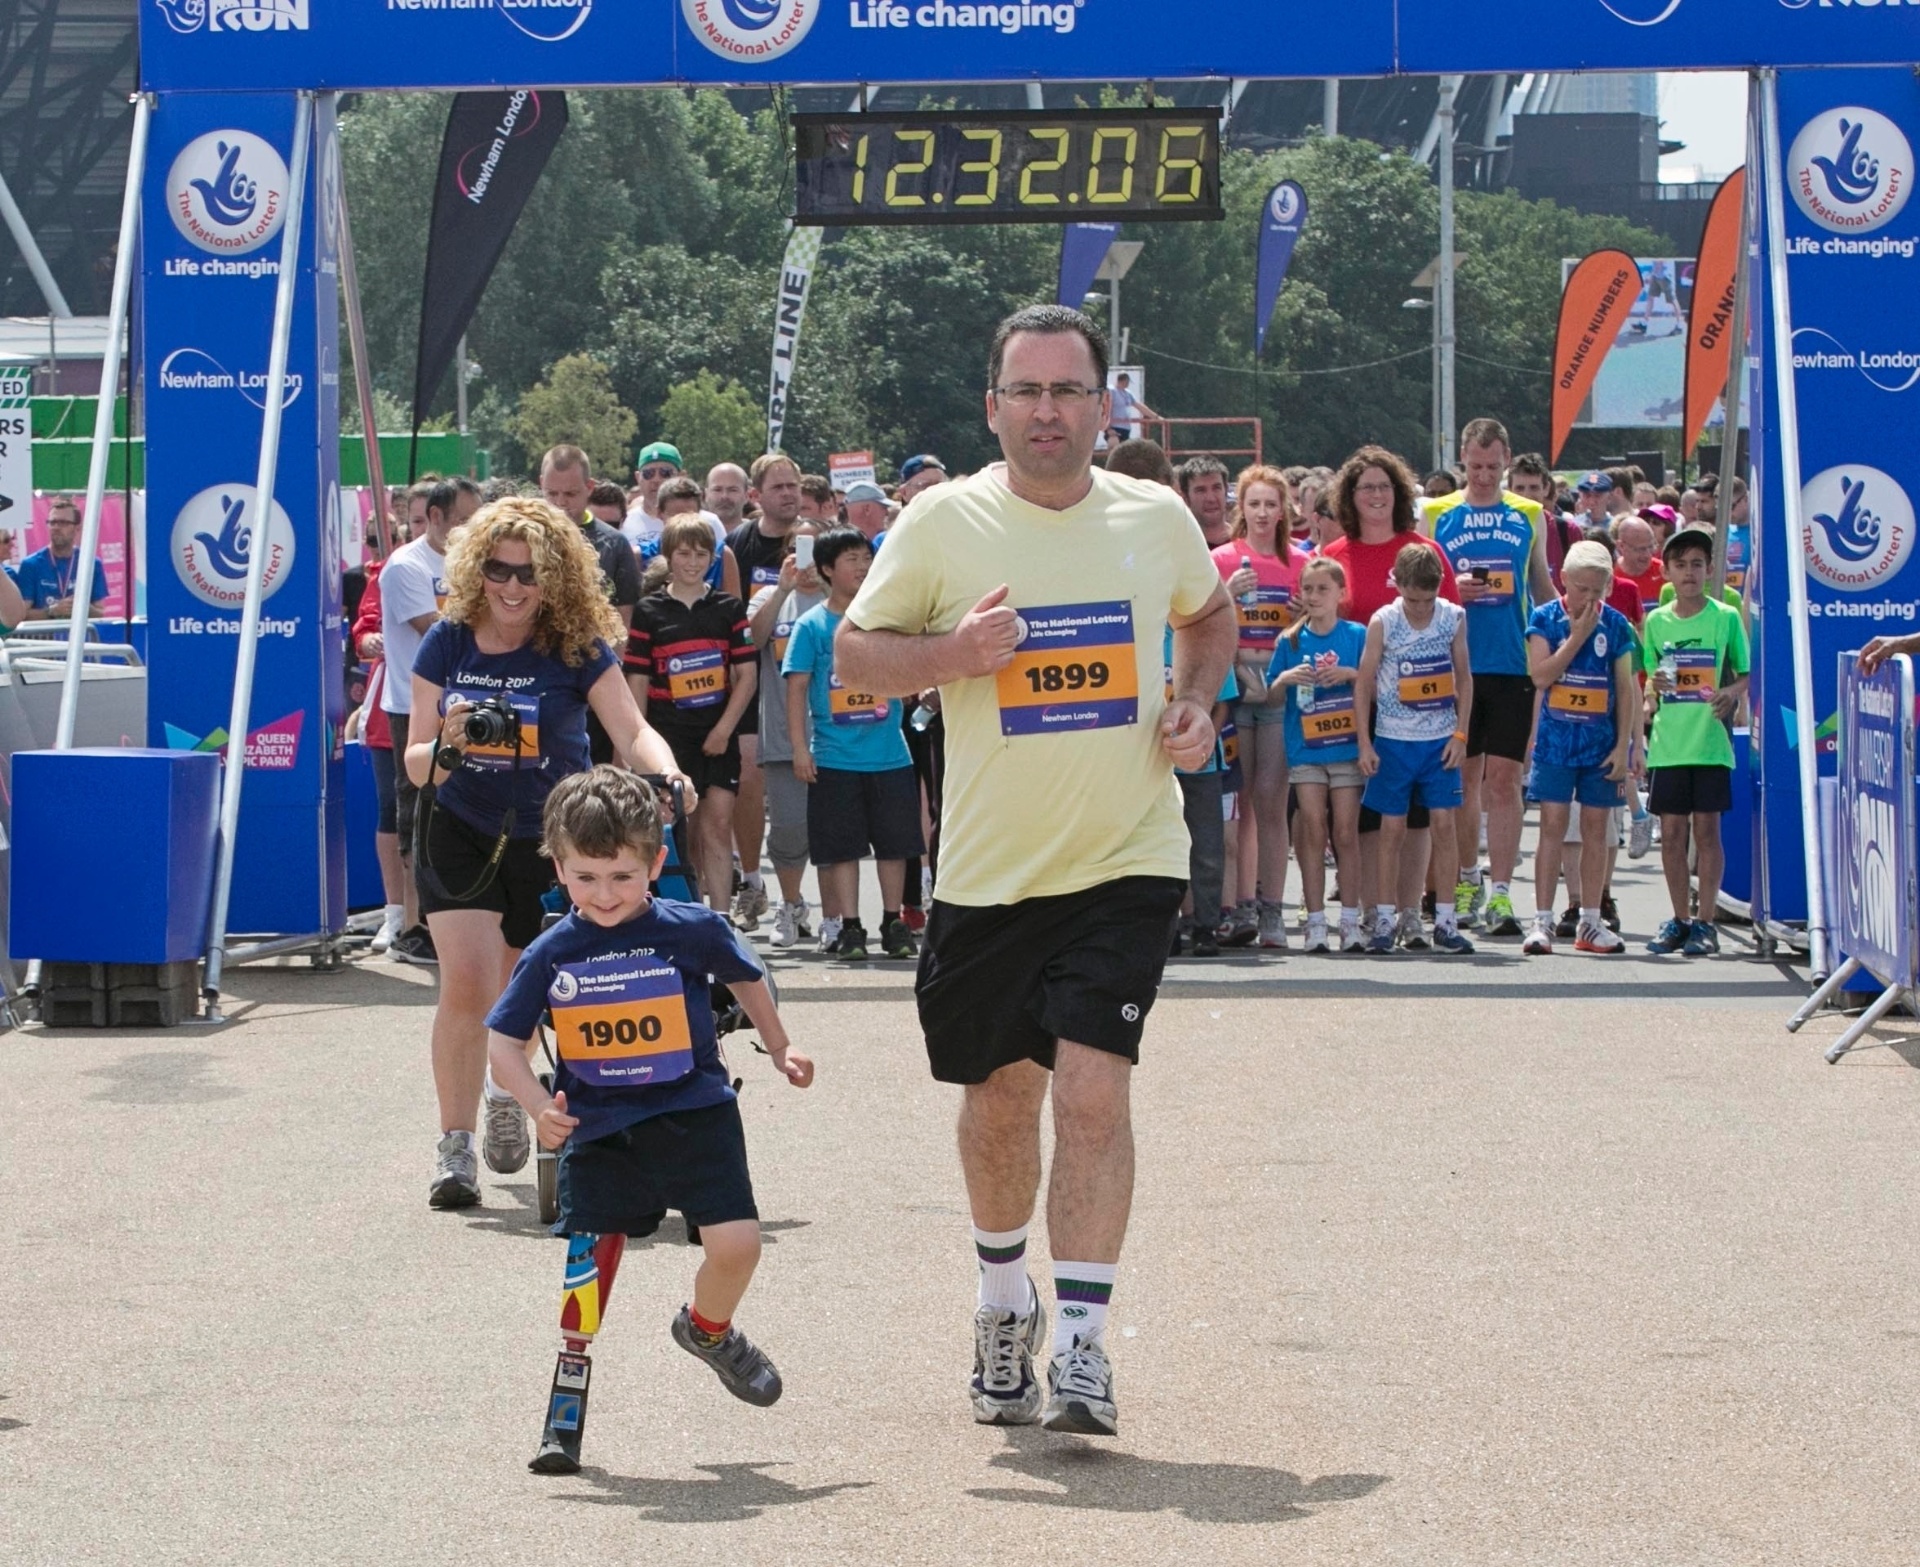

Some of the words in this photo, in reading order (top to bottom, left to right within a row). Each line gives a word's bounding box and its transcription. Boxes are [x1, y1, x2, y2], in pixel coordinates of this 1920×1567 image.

[850, 0, 909, 28] Life
[916, 0, 1075, 34] changing
[704, 23, 772, 55] National
[772, 0, 804, 46] Lotter
[467, 138, 506, 204] Newham
[495, 89, 530, 137] Londo
[1799, 168, 1813, 197] The
[1809, 197, 1870, 227] National
[1870, 168, 1903, 219] Lottery
[178, 190, 192, 219] The
[188, 219, 249, 248] National
[249, 190, 280, 240] Lottery
[1786, 237, 1820, 254] Life
[1823, 236, 1914, 258] changing
[165, 259, 199, 276] Life
[202, 258, 282, 279] changin
[776, 271, 807, 361] LINE
[1700, 273, 1737, 350] ORANG
[1560, 335, 1595, 390] ORANGE
[1588, 269, 1629, 335] NUMBERS
[1793, 352, 1855, 368] ewham
[160, 371, 234, 388] Newham
[239, 370, 303, 388] Lonon
[769, 371, 786, 450] ART
[1463, 512, 1504, 528] ANDY
[1445, 531, 1475, 552] RUN
[1476, 531, 1491, 540] for
[1493, 529, 1522, 547] RON
[1802, 525, 1814, 553] The
[1811, 553, 1872, 584] National
[1871, 525, 1904, 576] Lottery
[183, 544, 196, 573] The
[192, 572, 247, 600] Nationa
[262, 544, 285, 588] ottery
[1243, 609, 1280, 622] 1800
[1824, 598, 1915, 621] changing
[170, 618, 204, 634] Life
[206, 617, 296, 638] chaging
[1030, 621, 1048, 629] The
[1049, 617, 1092, 628] National
[1092, 614, 1129, 624] Lottery
[1044, 628, 1078, 637] Changing
[456, 672, 503, 688] London
[505, 677, 535, 689] 2012
[685, 674, 715, 691] 1116
[1025, 661, 1109, 693] 1899
[1421, 682, 1437, 695] 61
[847, 693, 874, 706] 622
[1570, 694, 1588, 706] 73
[1042, 713, 1072, 723] Newham
[1073, 711, 1099, 720] London
[1314, 716, 1352, 732] 1802
[256, 733, 295, 746] QUEEN
[244, 745, 294, 755] IZABETH
[260, 756, 291, 767] PARK
[578, 976, 597, 985] The
[597, 970, 639, 983] National
[640, 966, 676, 978] Lottery
[578, 1014, 663, 1048] 1900
[627, 1065, 653, 1075] London
